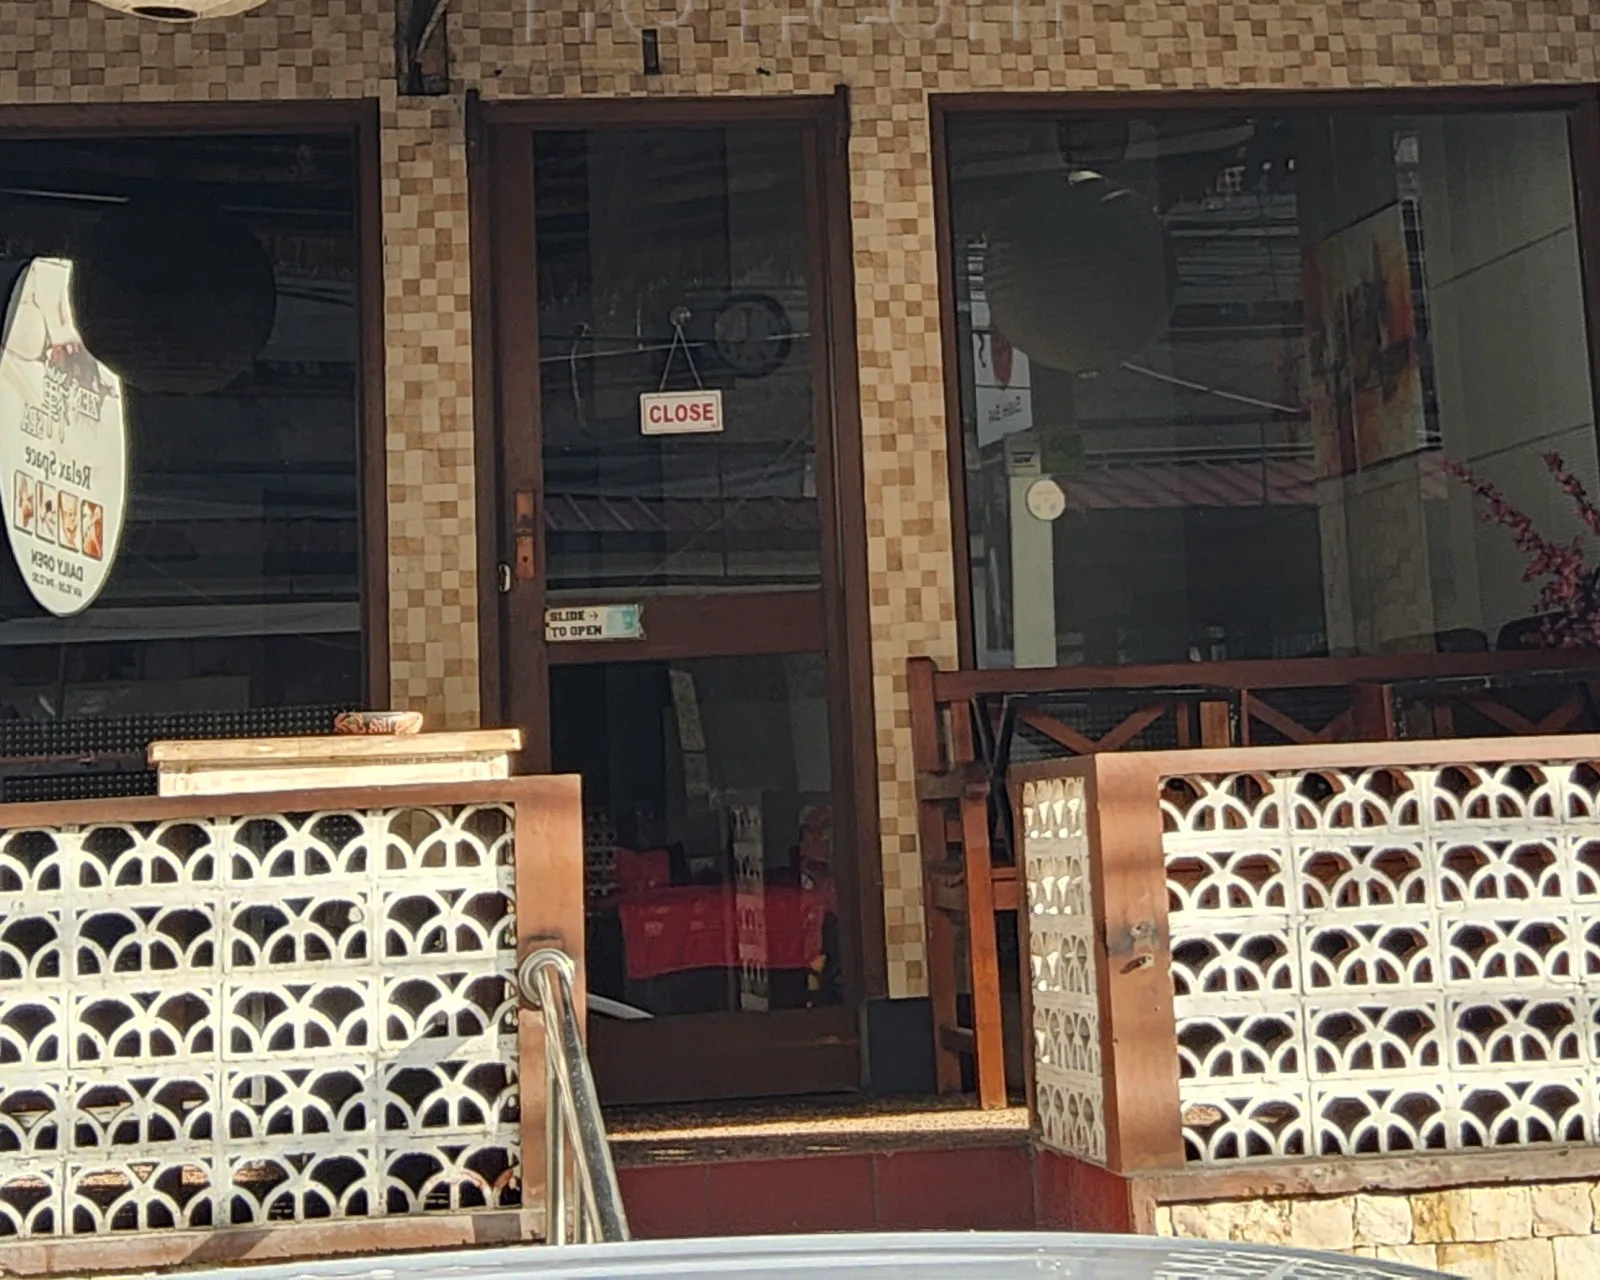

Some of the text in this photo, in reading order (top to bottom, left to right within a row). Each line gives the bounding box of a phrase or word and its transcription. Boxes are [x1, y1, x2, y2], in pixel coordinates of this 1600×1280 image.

[648, 402, 715, 424] CLOSE
[550, 610, 585, 622] SLIDE
[551, 624, 603, 638] TO OPEN
